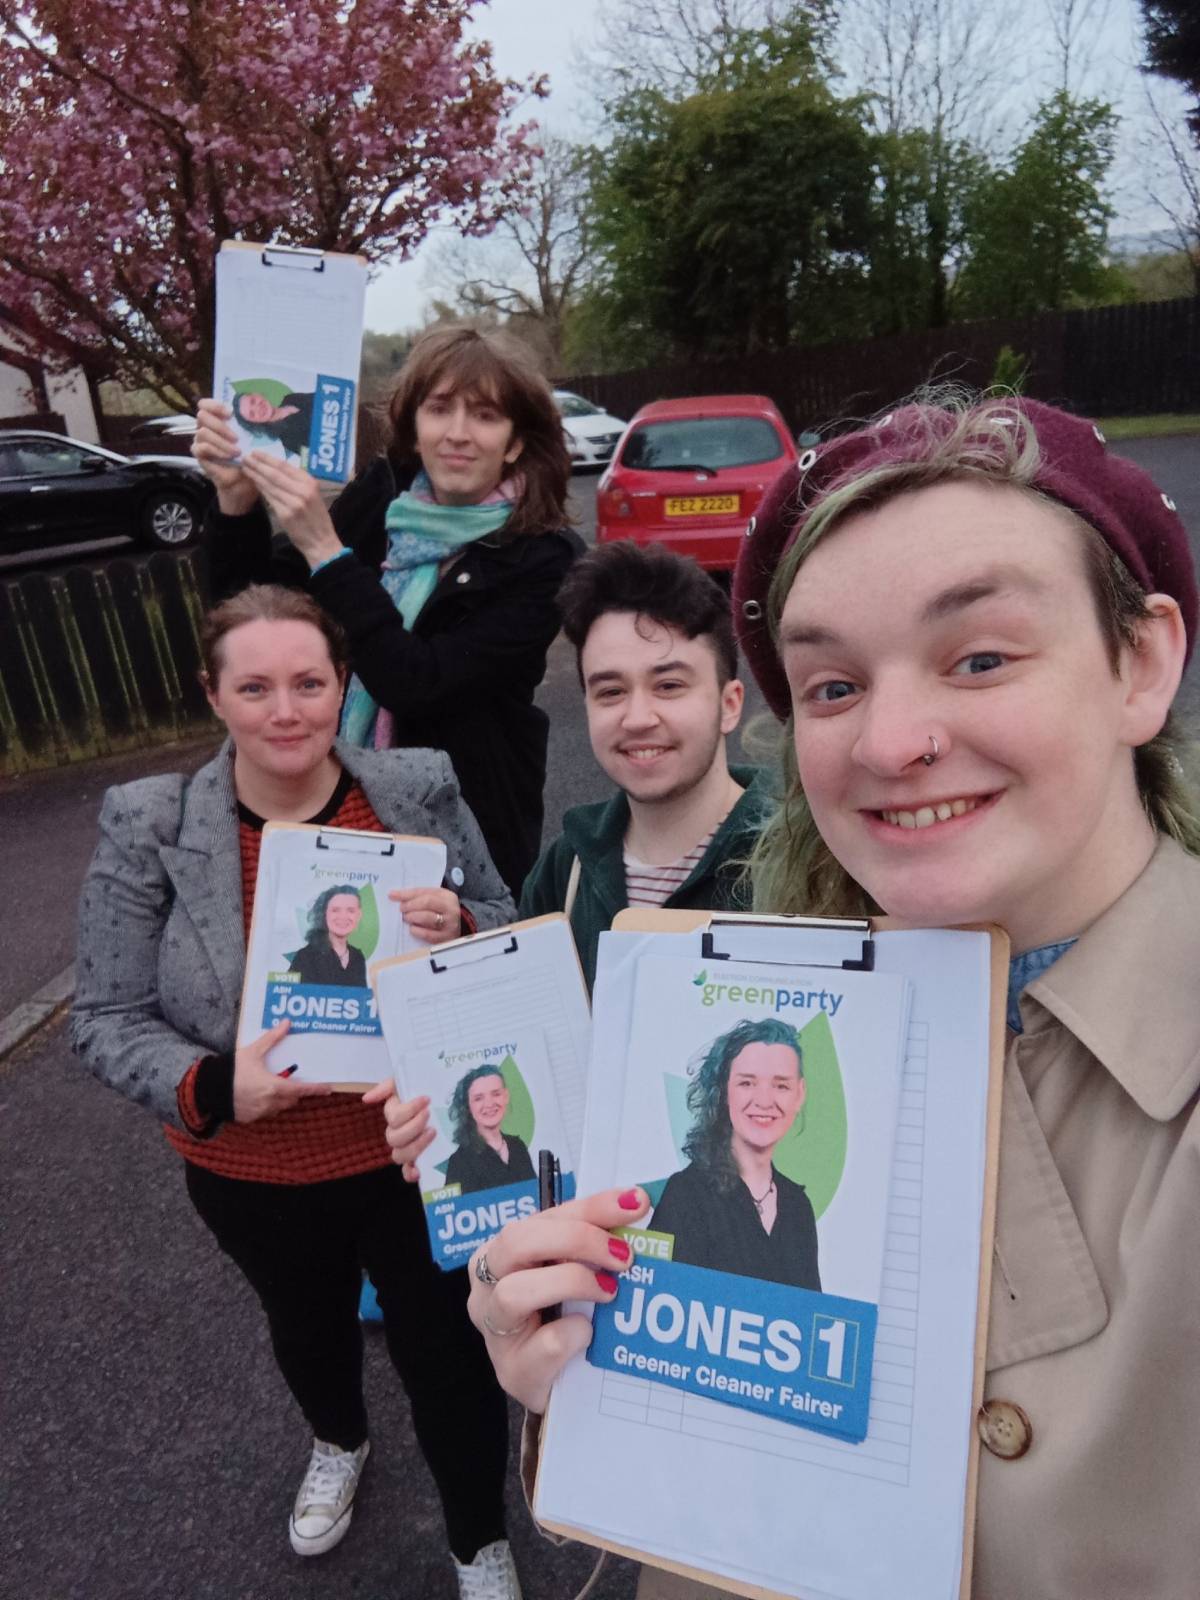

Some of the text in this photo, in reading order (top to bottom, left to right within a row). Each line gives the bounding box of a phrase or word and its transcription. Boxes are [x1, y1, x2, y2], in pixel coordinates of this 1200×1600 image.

[318, 400, 340, 472] JONES
[671, 500, 696, 512] FEZ
[271, 994, 360, 1020] JONES
[702, 982, 844, 1017] greenparty
[445, 1042, 518, 1068] greenparty
[432, 1186, 461, 1201] VOTE
[438, 1196, 537, 1240] JONES
[623, 1232, 670, 1259] VOTE
[614, 1287, 846, 1380] JONES 1
[613, 1345, 843, 1420] Greener Cleaner Fairer
